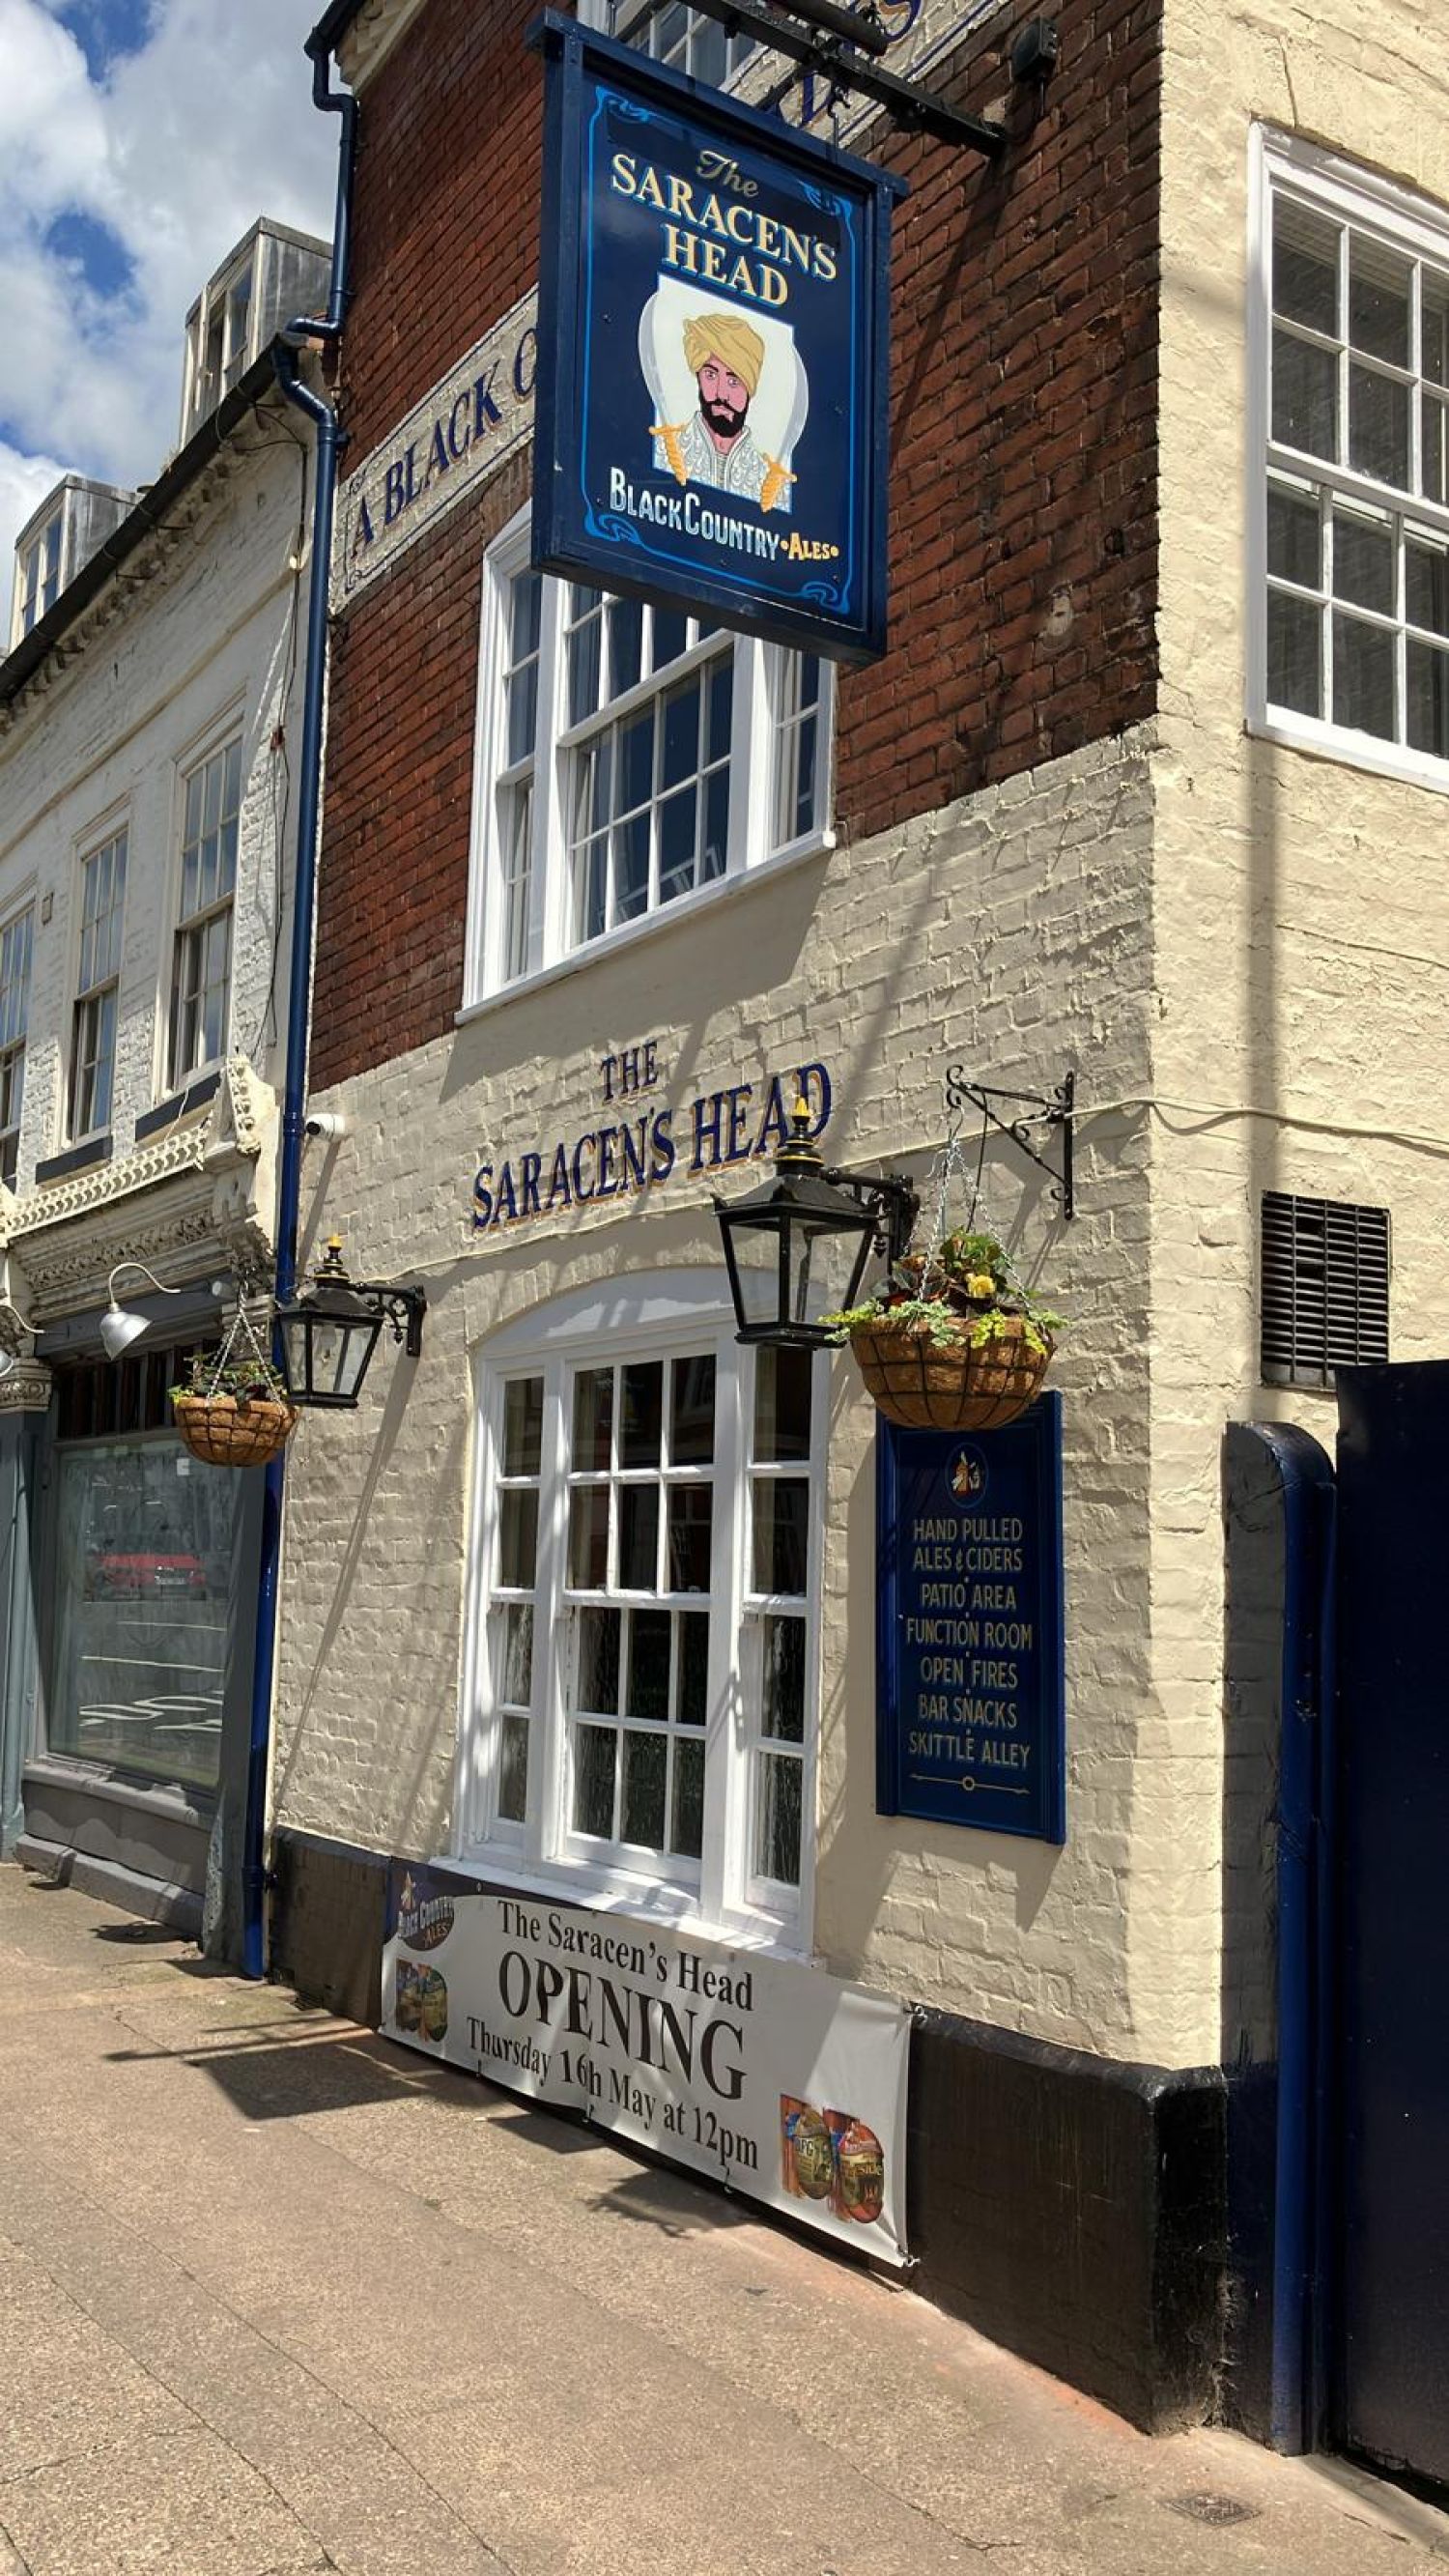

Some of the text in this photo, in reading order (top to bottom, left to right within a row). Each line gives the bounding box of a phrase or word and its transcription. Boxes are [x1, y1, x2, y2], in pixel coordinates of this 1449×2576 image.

[695, 149, 759, 198] The
[611, 153, 838, 281] SARACEN'S
[661, 222, 788, 307] HEAD
[351, 359, 503, 559] A BLACK
[600, 1040, 659, 1102] THE
[471, 1062, 833, 1230] SARACEN'S HEAD
[913, 1517, 1024, 1543] HAND PULLED
[912, 1546, 1024, 1572] ALES & CIDERS
[922, 1583, 1017, 1611] PATIO AREA
[907, 1617, 1033, 1651] FUNCTION ROOM
[920, 1656, 1018, 1689] OPEN FIRES
[919, 1693, 1017, 1730] BAR SNACKS
[908, 1731, 1032, 1770] SKITTLE ALLEY
[497, 1900, 754, 2012] The Saracen's Head
[498, 1950, 749, 2101] OPENING
[467, 2016, 552, 2087] Thursday
[609, 2067, 658, 2131] May
[664, 2100, 686, 2136] at
[694, 2105, 759, 2171] 12pm
